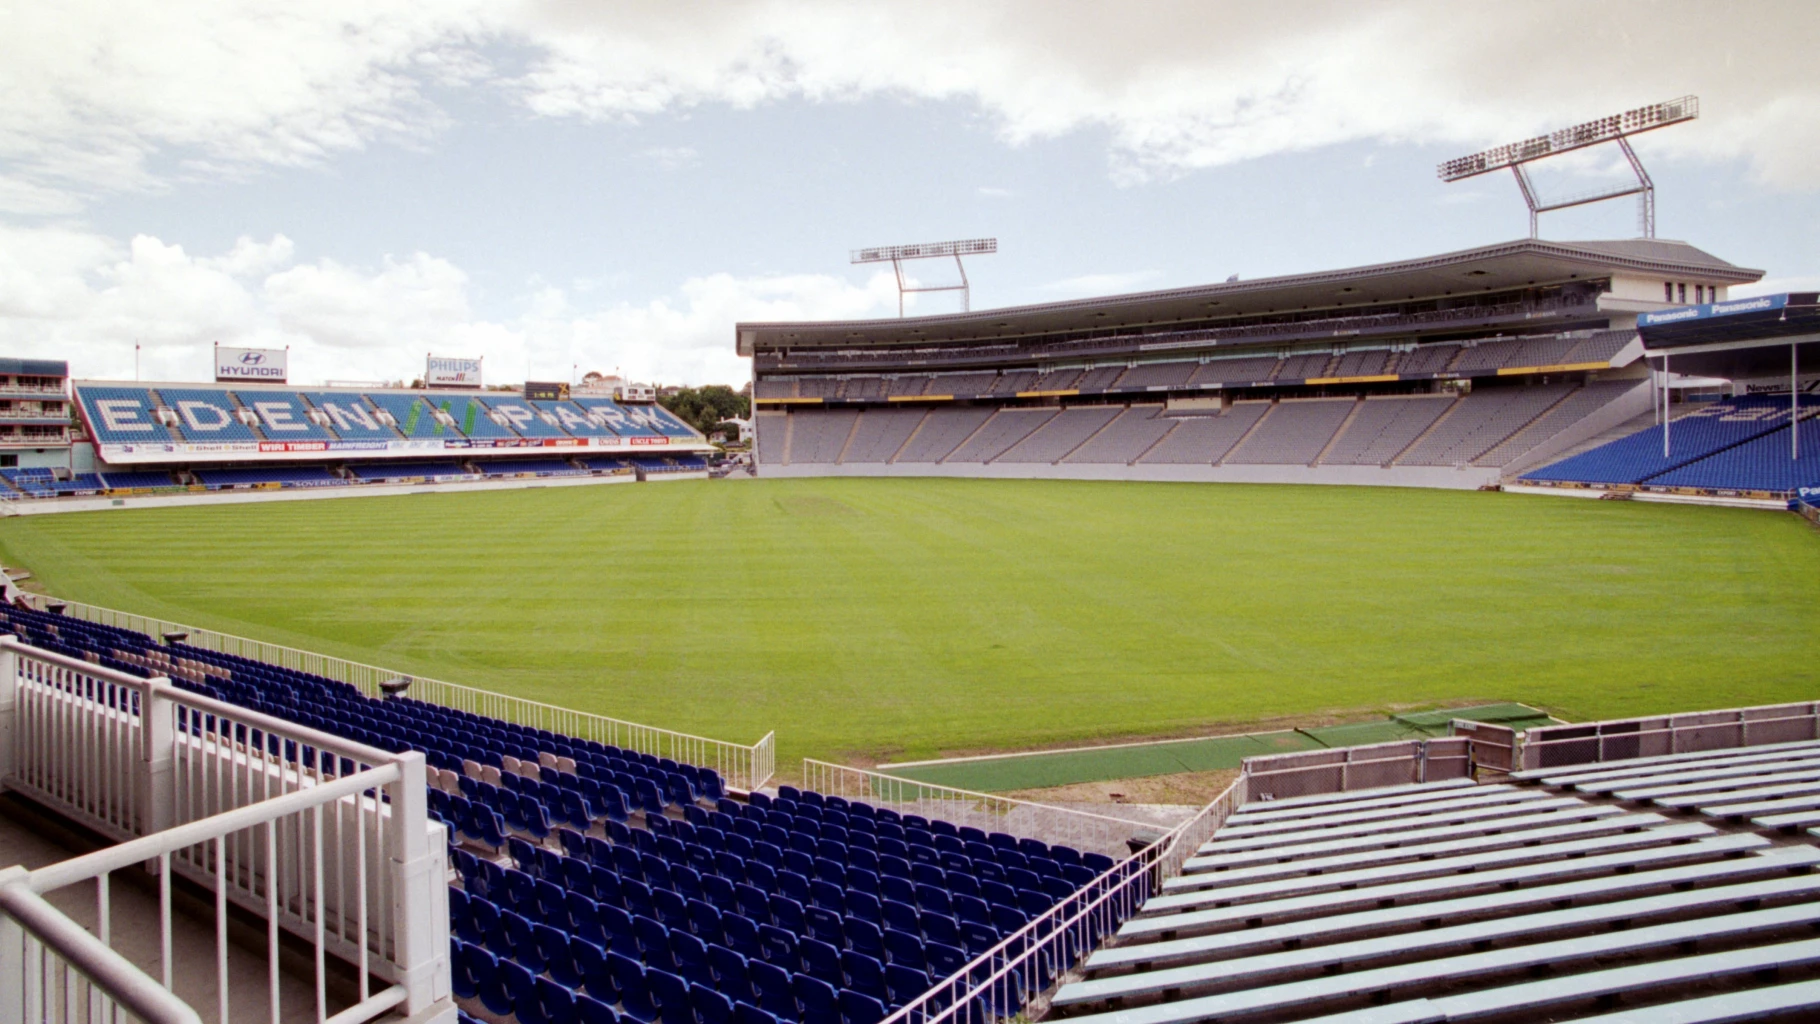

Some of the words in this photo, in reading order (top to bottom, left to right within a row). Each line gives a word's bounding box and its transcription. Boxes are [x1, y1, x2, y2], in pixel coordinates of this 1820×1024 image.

[1647, 308, 1698, 323] Panasonic
[1711, 298, 1771, 315] Panasonic
[220, 366, 283, 376] HYUNDAI
[430, 360, 479, 372] PHILIPS
[96, 399, 380, 432] EDEN
[498, 405, 680, 430] PARK
[261, 443, 285, 451] WIRI
[286, 443, 326, 451] TIMBER
[328, 442, 387, 450] MAINFREIGHT
[295, 479, 348, 487] SOVEREIGN
